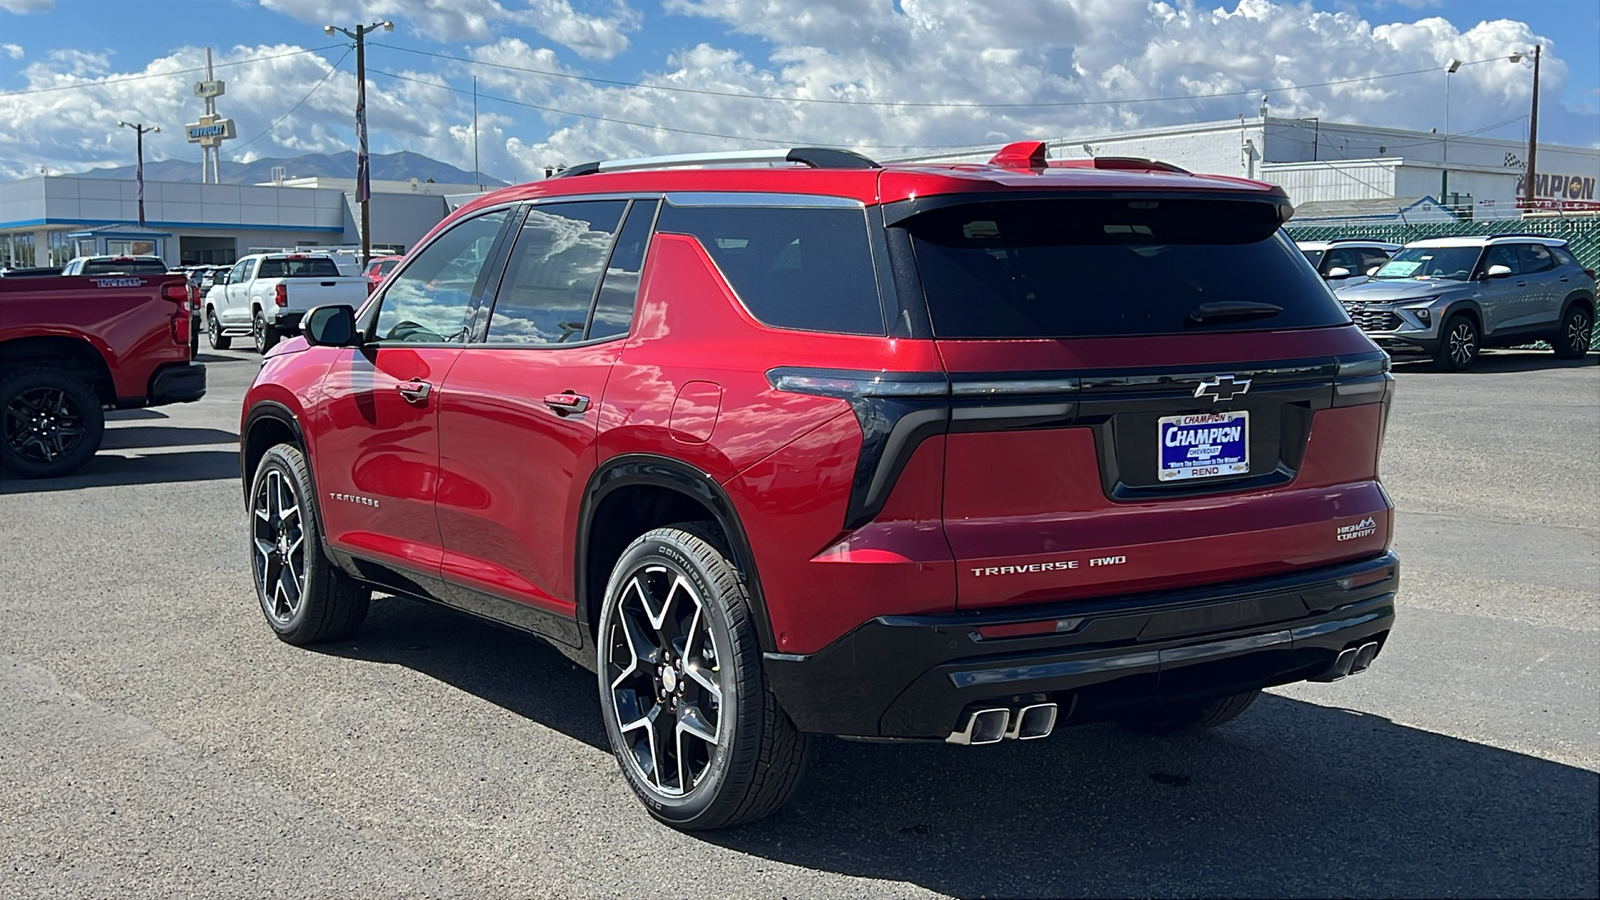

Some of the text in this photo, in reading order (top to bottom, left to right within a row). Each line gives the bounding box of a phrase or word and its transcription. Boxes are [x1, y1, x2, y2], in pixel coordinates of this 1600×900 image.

[1516, 173, 1596, 199] AMPION
[1183, 414, 1227, 425] CHAMPION
[1165, 426, 1241, 448] CHAMPION
[1189, 447, 1220, 456] CHEVROLET
[1191, 467, 1219, 477] RENO
[329, 493, 380, 508] TRAVERSE
[1337, 524, 1361, 535] HIGH
[1337, 528, 1376, 541] COUNTRY
[970, 555, 1127, 577] TRAVERSE AWD
[658, 545, 716, 618] CONTINENTAL
